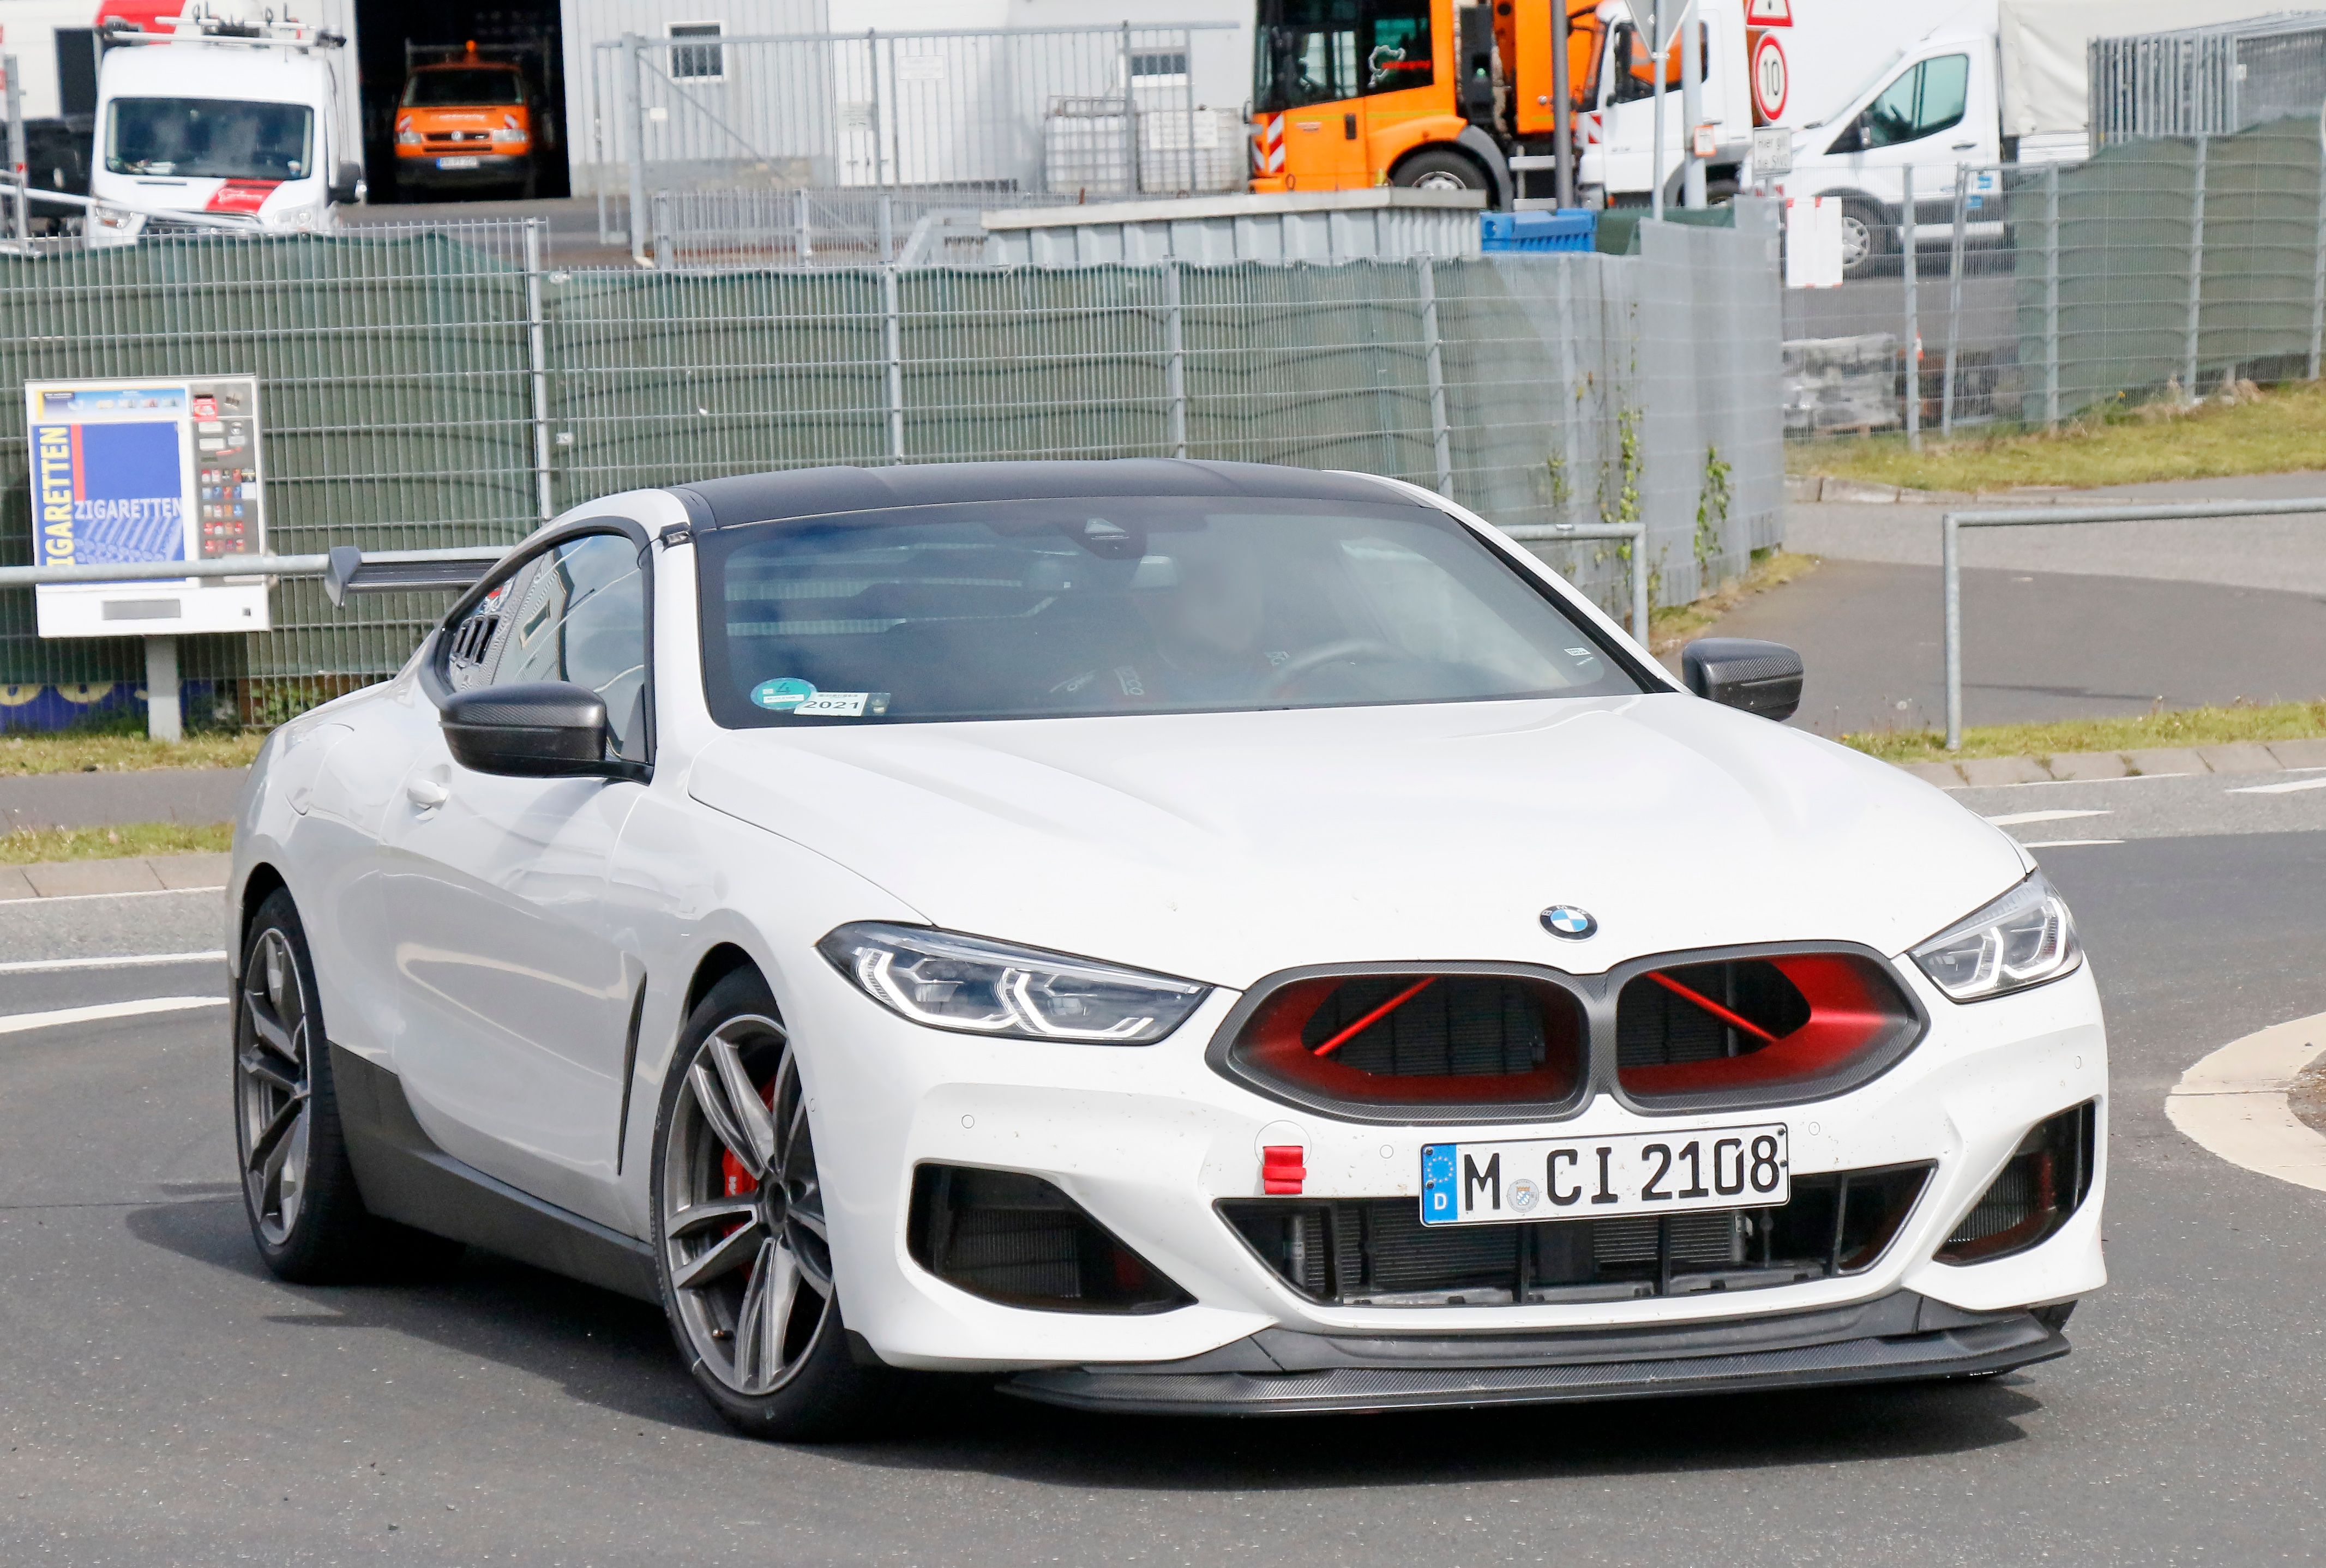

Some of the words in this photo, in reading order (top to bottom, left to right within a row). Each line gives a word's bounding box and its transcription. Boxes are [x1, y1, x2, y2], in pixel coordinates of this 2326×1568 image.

[1764, 59, 1780, 95] 10
[39, 427, 75, 566] IGARETTEN
[776, 682, 791, 693] 4
[803, 701, 859, 709] 2021
[1541, 904, 1588, 916] BMW
[1464, 1153, 1501, 1211] M
[1547, 1147, 1618, 1206] CI
[1640, 1135, 1779, 1202] 2108
[1433, 1195, 1447, 1210] D
